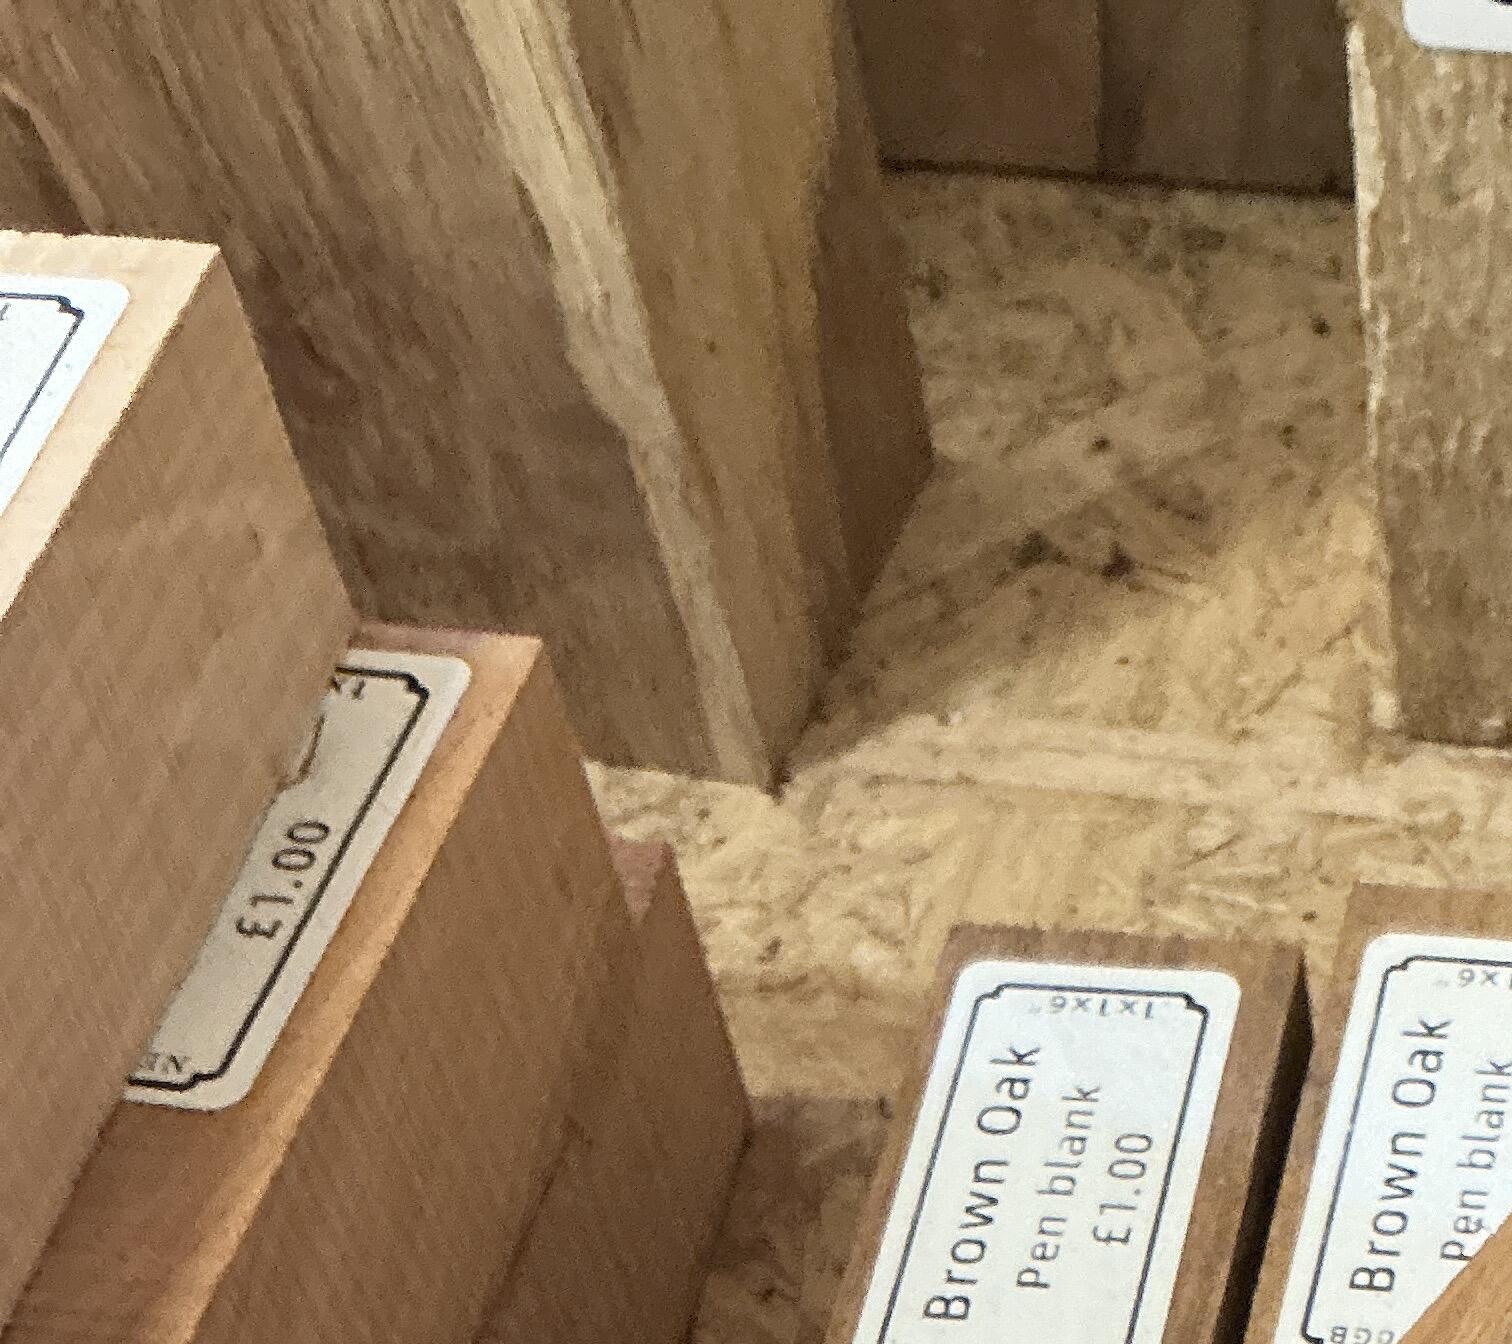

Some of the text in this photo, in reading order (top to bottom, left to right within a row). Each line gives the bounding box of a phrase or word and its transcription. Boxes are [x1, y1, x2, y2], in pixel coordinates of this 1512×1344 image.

[235, 821, 330, 939] £1.00
[924, 1044, 1041, 1322] Brown Oak
[1016, 1083, 1102, 1290] Pen blank
[1092, 1132, 1153, 1246] £1.00
[1350, 1130, 1427, 1293] Brown
[1392, 1017, 1453, 1107] Oak
[1440, 1190, 1489, 1261] Pen
